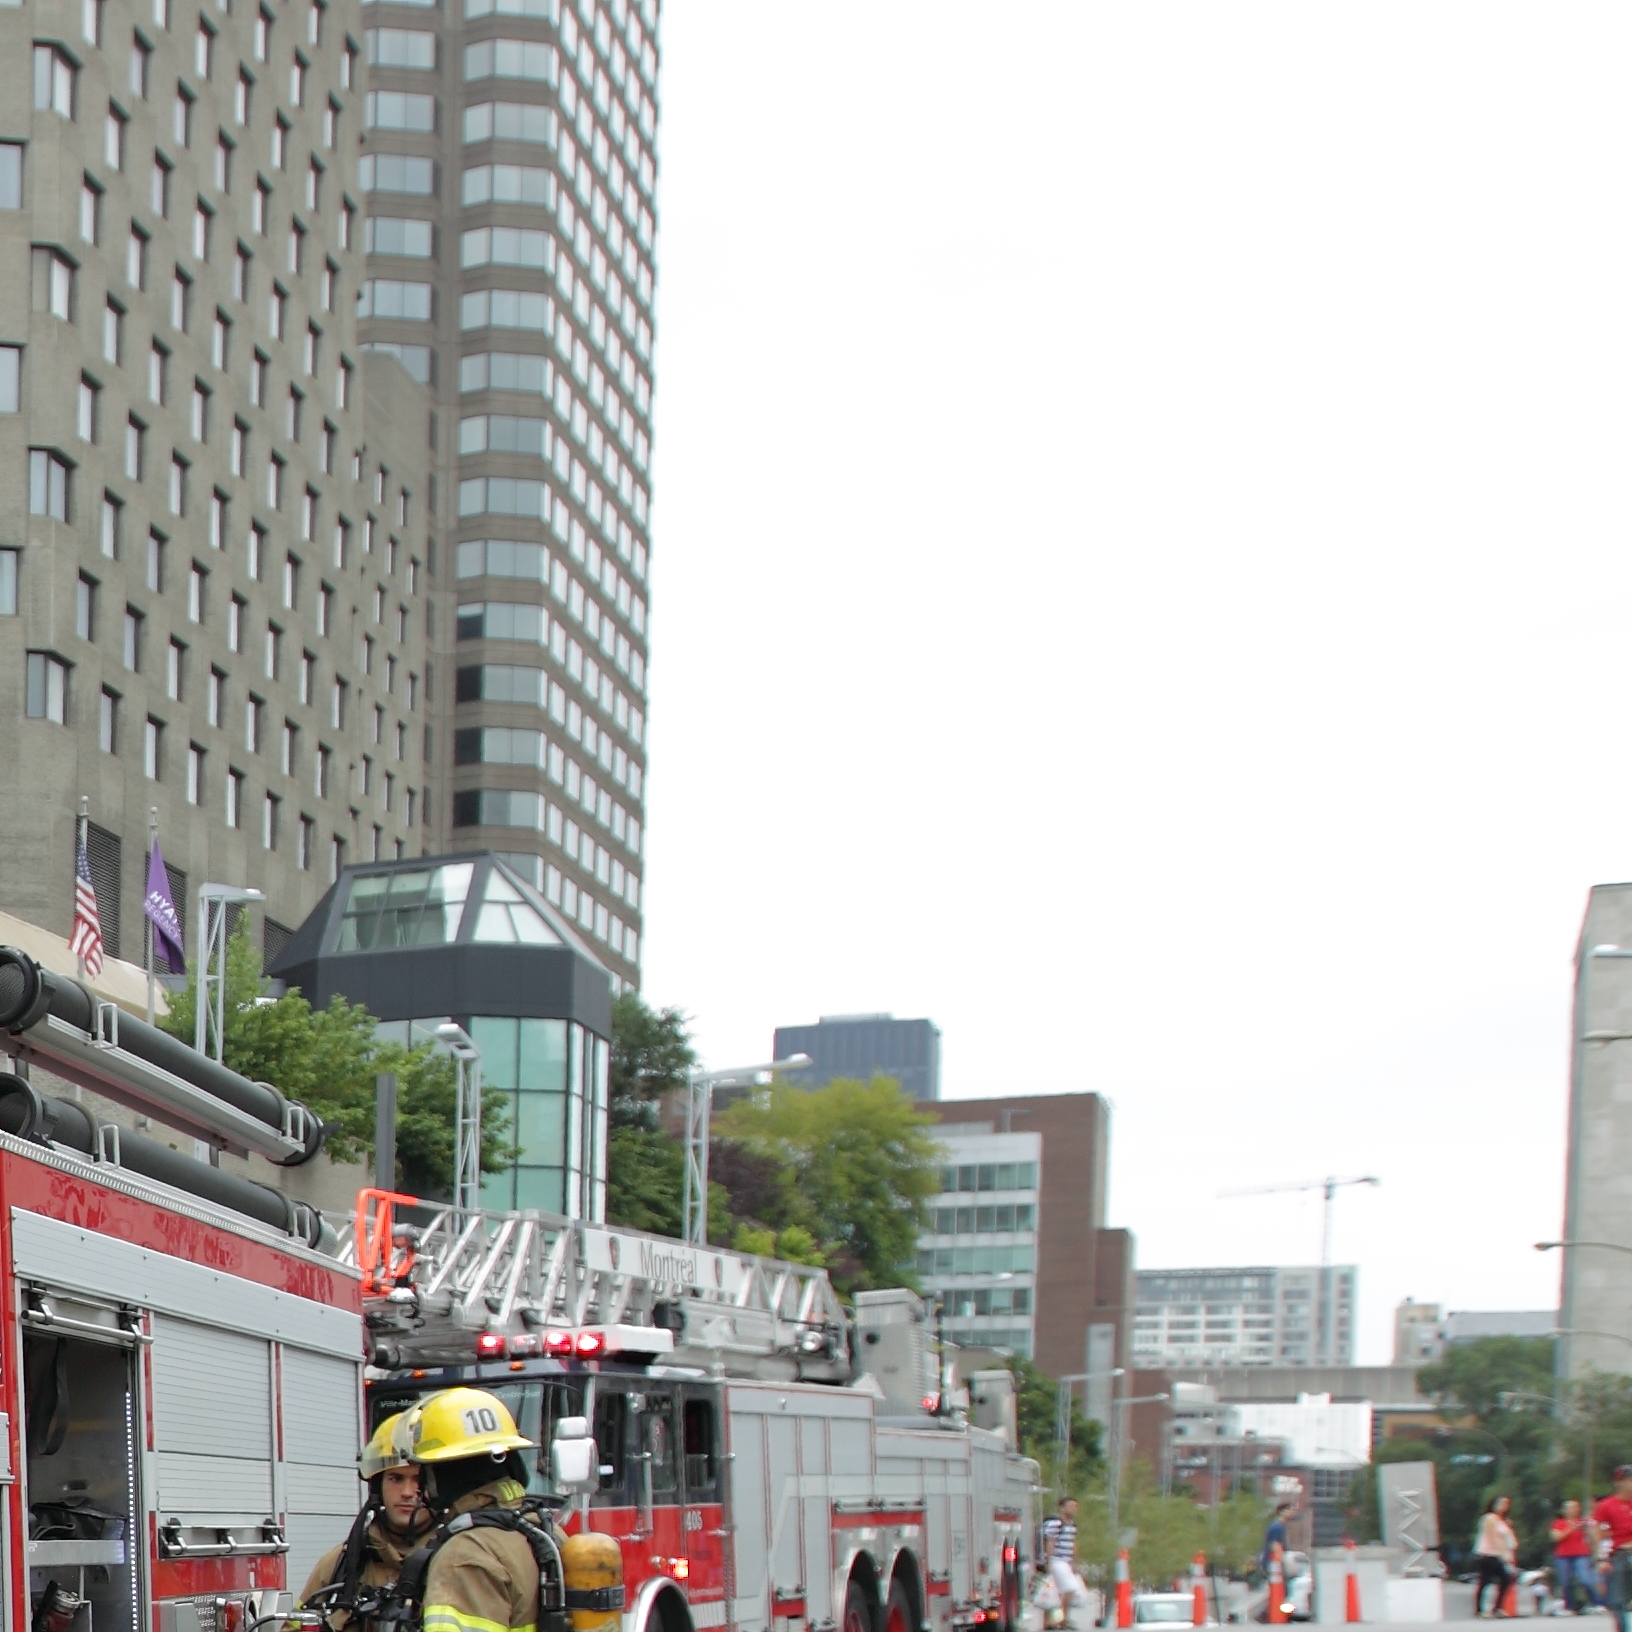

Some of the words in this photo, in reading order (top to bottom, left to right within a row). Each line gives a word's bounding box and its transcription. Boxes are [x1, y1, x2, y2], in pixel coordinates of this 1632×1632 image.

[144, 899, 181, 938] REGENCY
[640, 1240, 697, 1284] Montréal
[465, 1407, 498, 1434] 10
